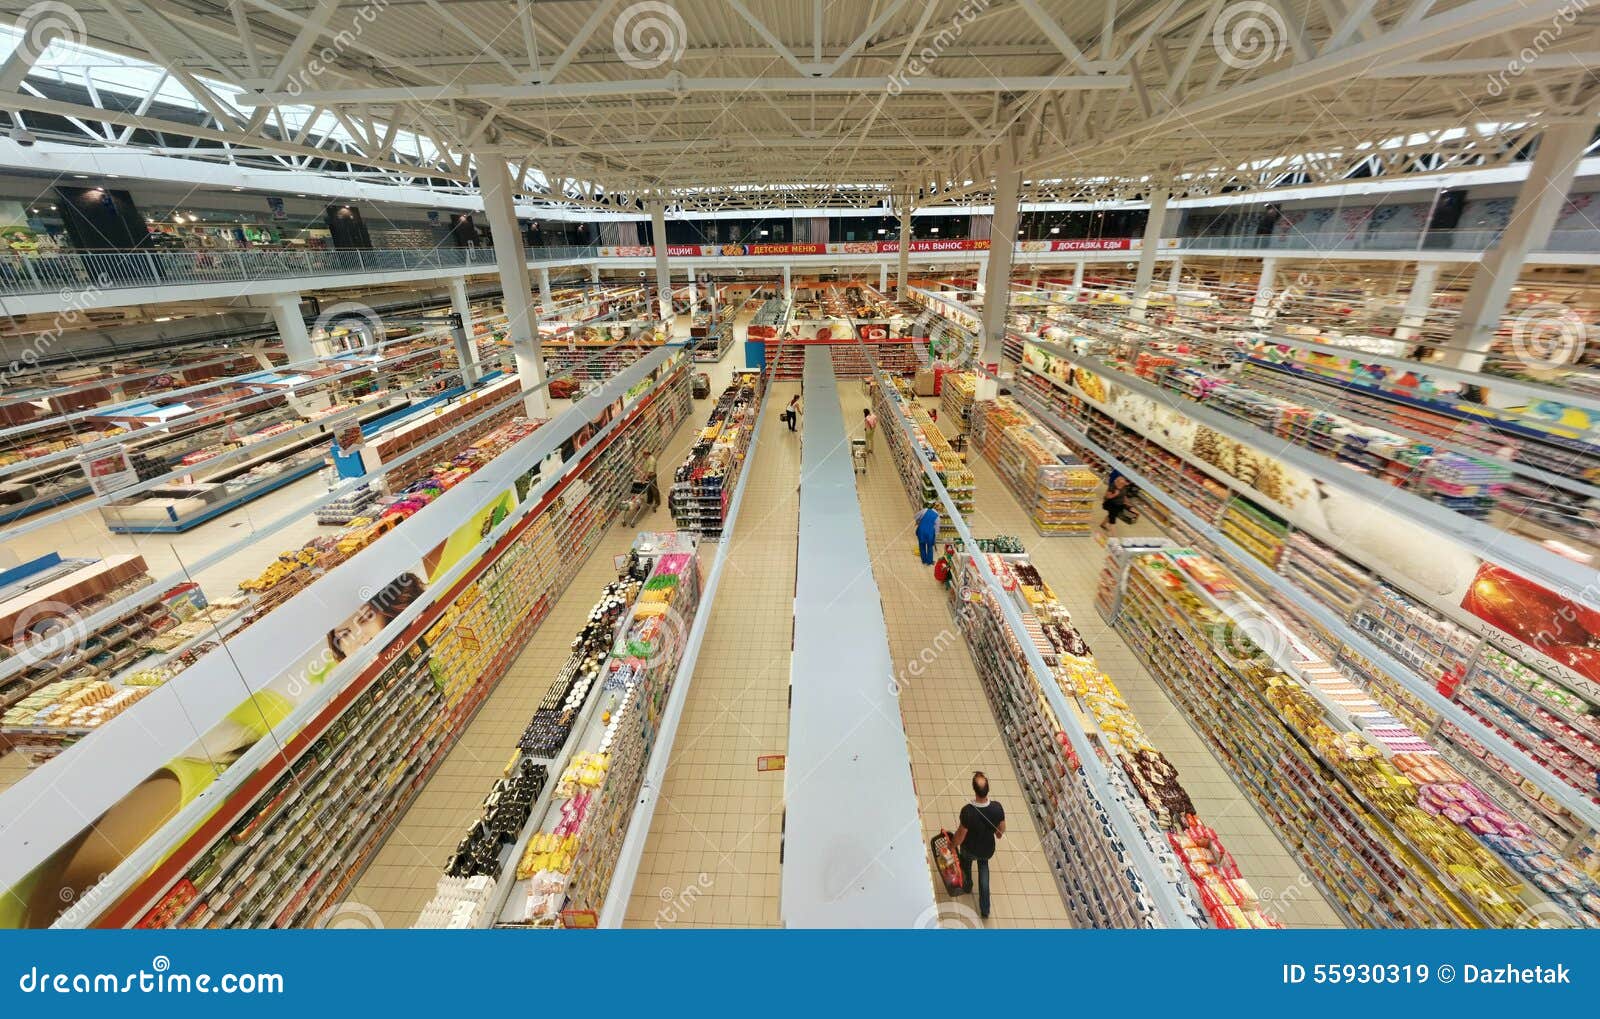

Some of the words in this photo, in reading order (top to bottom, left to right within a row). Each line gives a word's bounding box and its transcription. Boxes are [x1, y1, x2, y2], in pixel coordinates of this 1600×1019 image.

[754, 245, 789, 254] ДЕТСКОЕ
[791, 244, 817, 253] МЕНЮ
[882, 243, 916, 251] СКИА
[918, 242, 930, 250] НА
[932, 240, 963, 250] ВЫНОС
[1057, 241, 1101, 251] ДОСТАВКА
[1103, 241, 1122, 250] ЕДЫ
[666, 246, 693, 256] КЦИИ!
